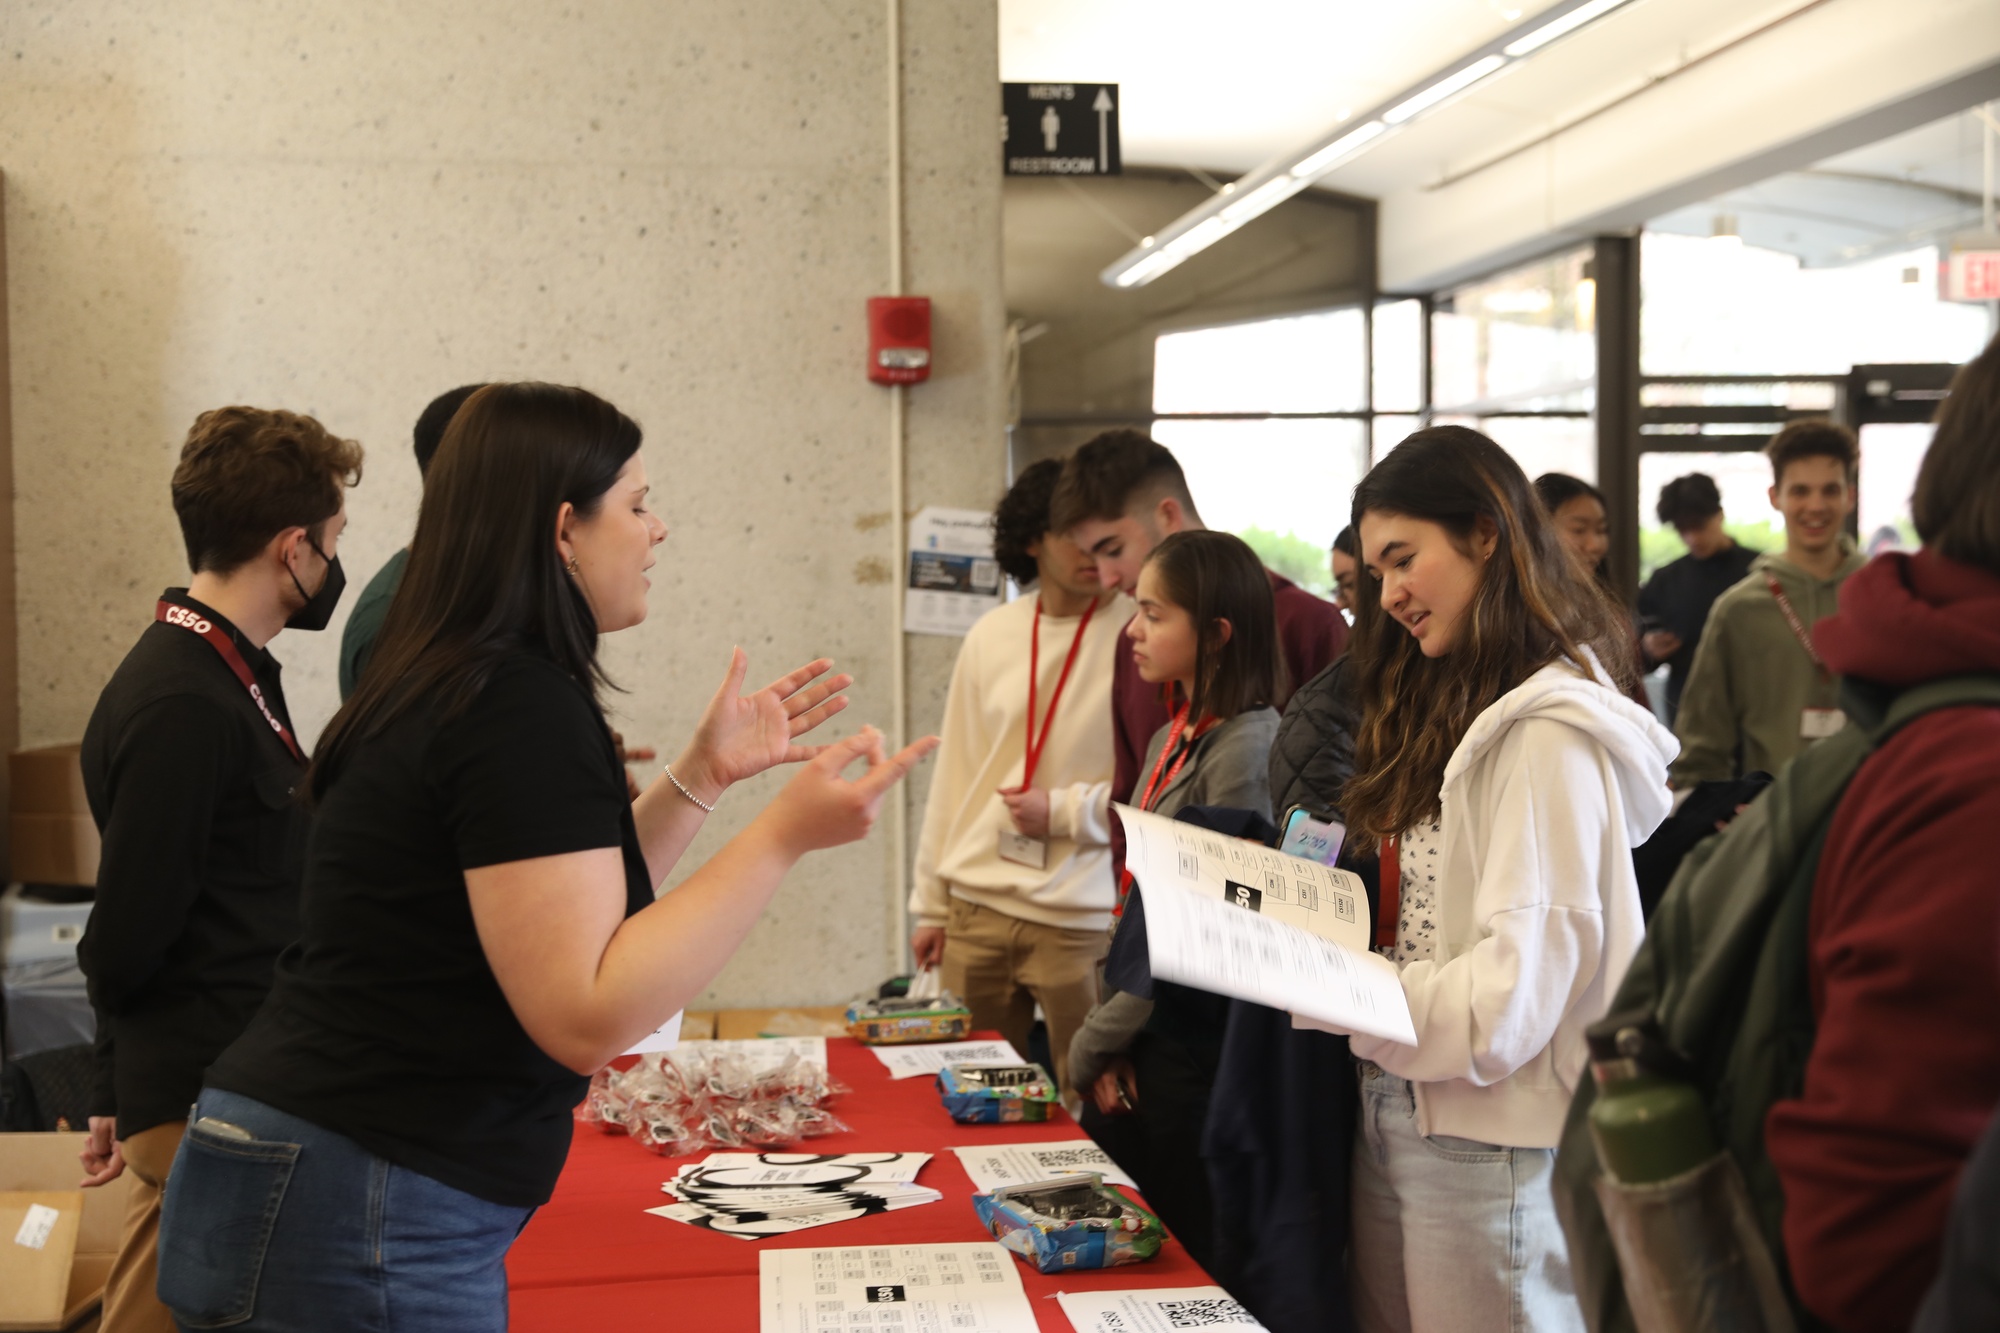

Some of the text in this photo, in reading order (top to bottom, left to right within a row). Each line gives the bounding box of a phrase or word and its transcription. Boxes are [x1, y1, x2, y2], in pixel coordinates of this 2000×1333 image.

[1027, 84, 1075, 101] MEN'S
[1008, 156, 1096, 174] RESTROOM
[165, 606, 212, 634] CS50
[1235, 886, 1250, 909] 50
